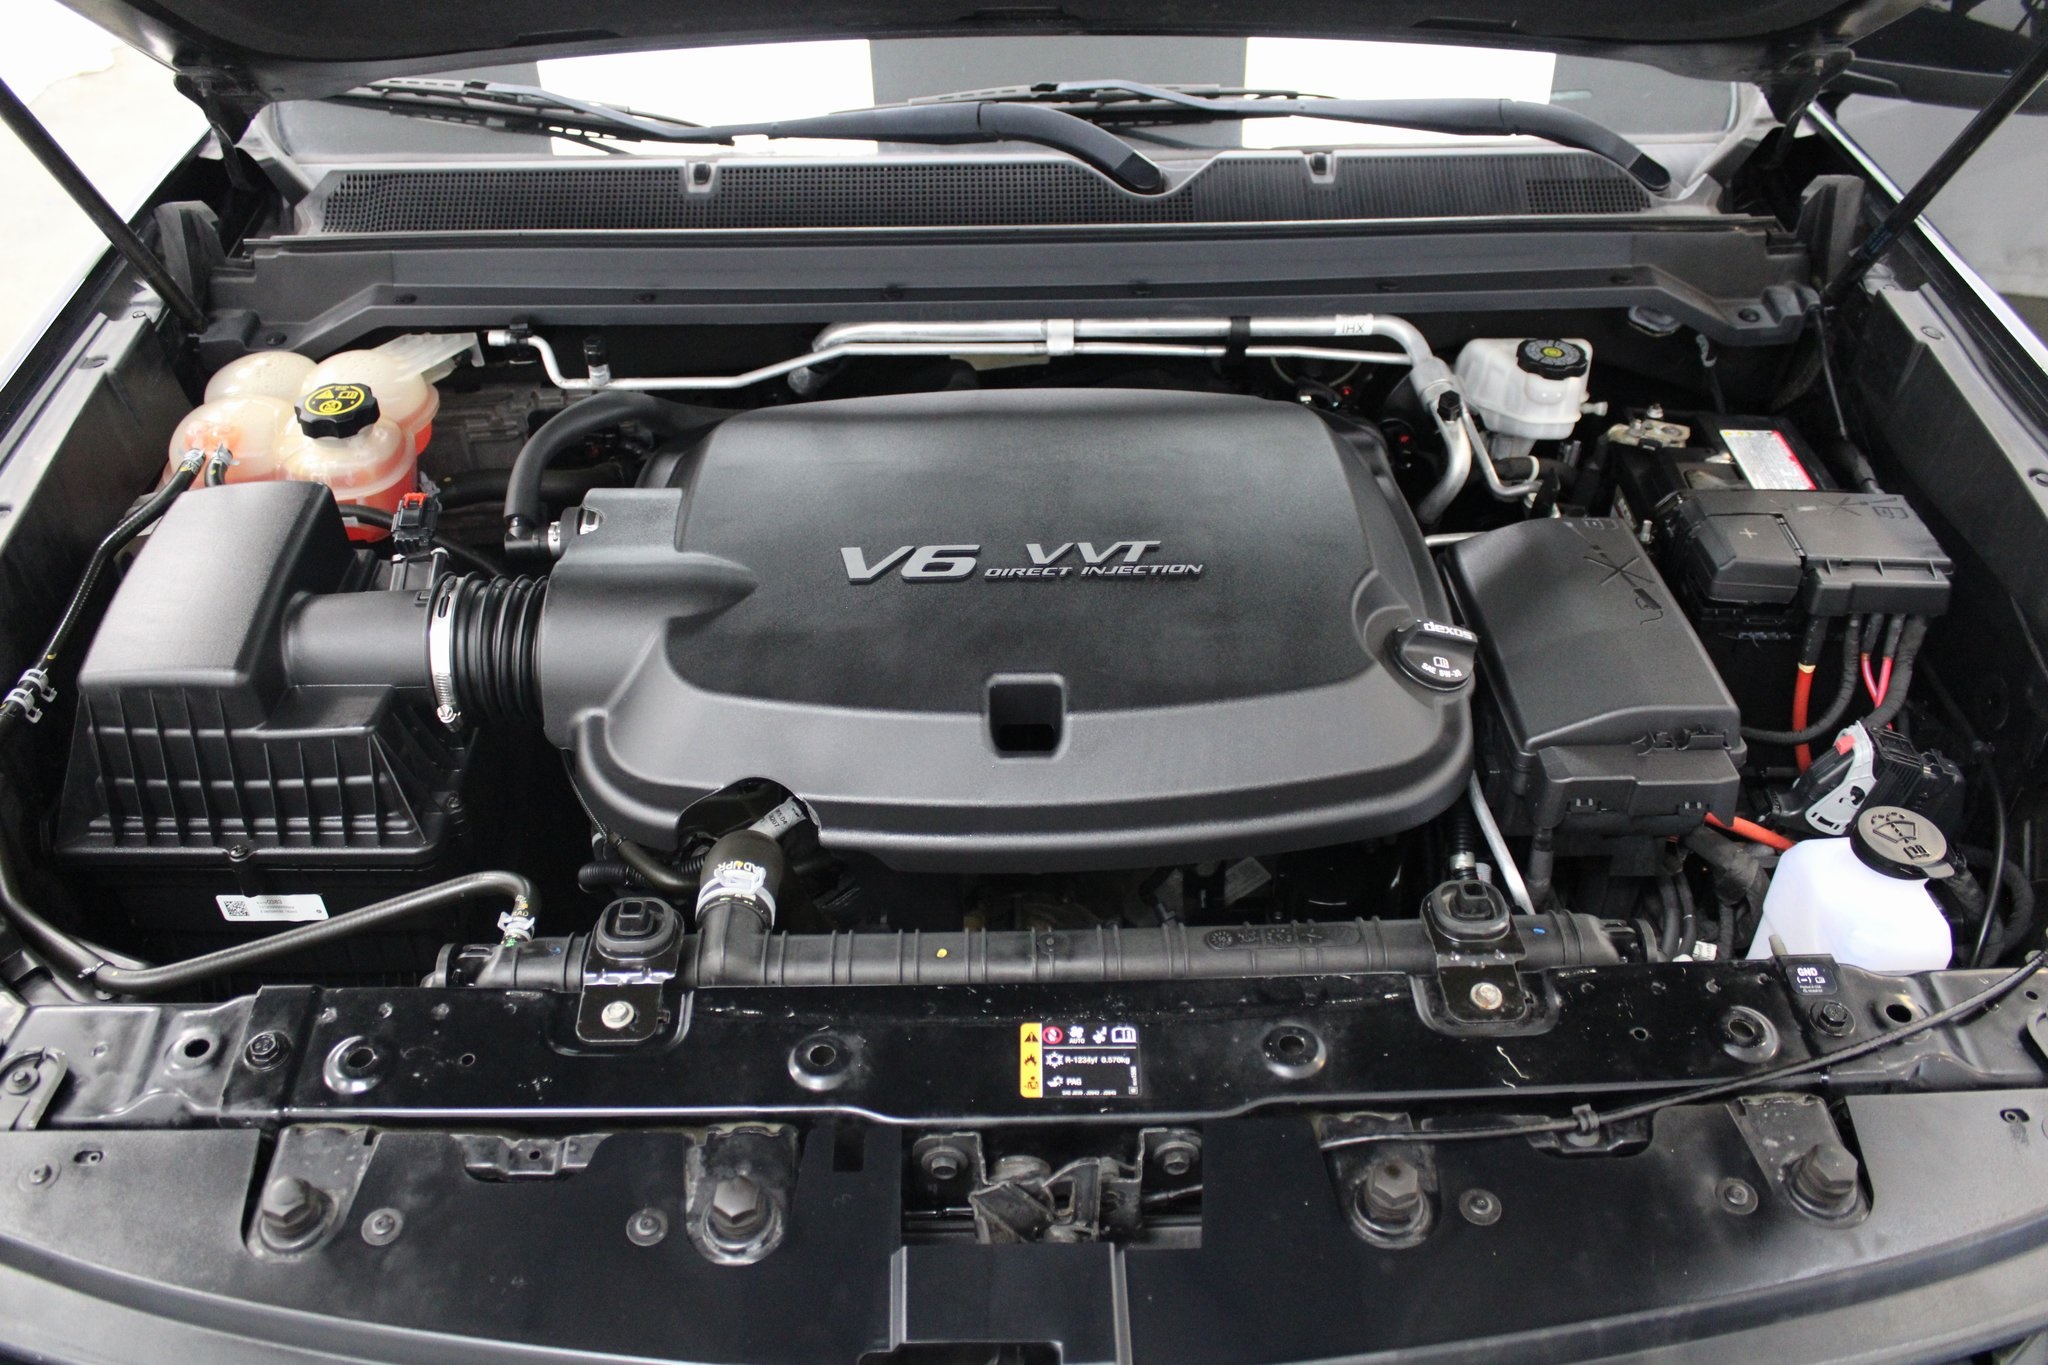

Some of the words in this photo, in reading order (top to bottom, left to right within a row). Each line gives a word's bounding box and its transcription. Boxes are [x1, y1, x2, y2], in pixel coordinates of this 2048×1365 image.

[1026, 540, 1161, 565] VVT
[840, 544, 981, 583] V6
[984, 566, 1073, 578] DIRECT
[1080, 564, 1204, 577] INJECTION
[1423, 621, 1473, 640] dexos
[1797, 967, 1818, 977] GND
[1064, 1056, 1098, 1065] R-1234yf
[1066, 1077, 1082, 1086] PAG
